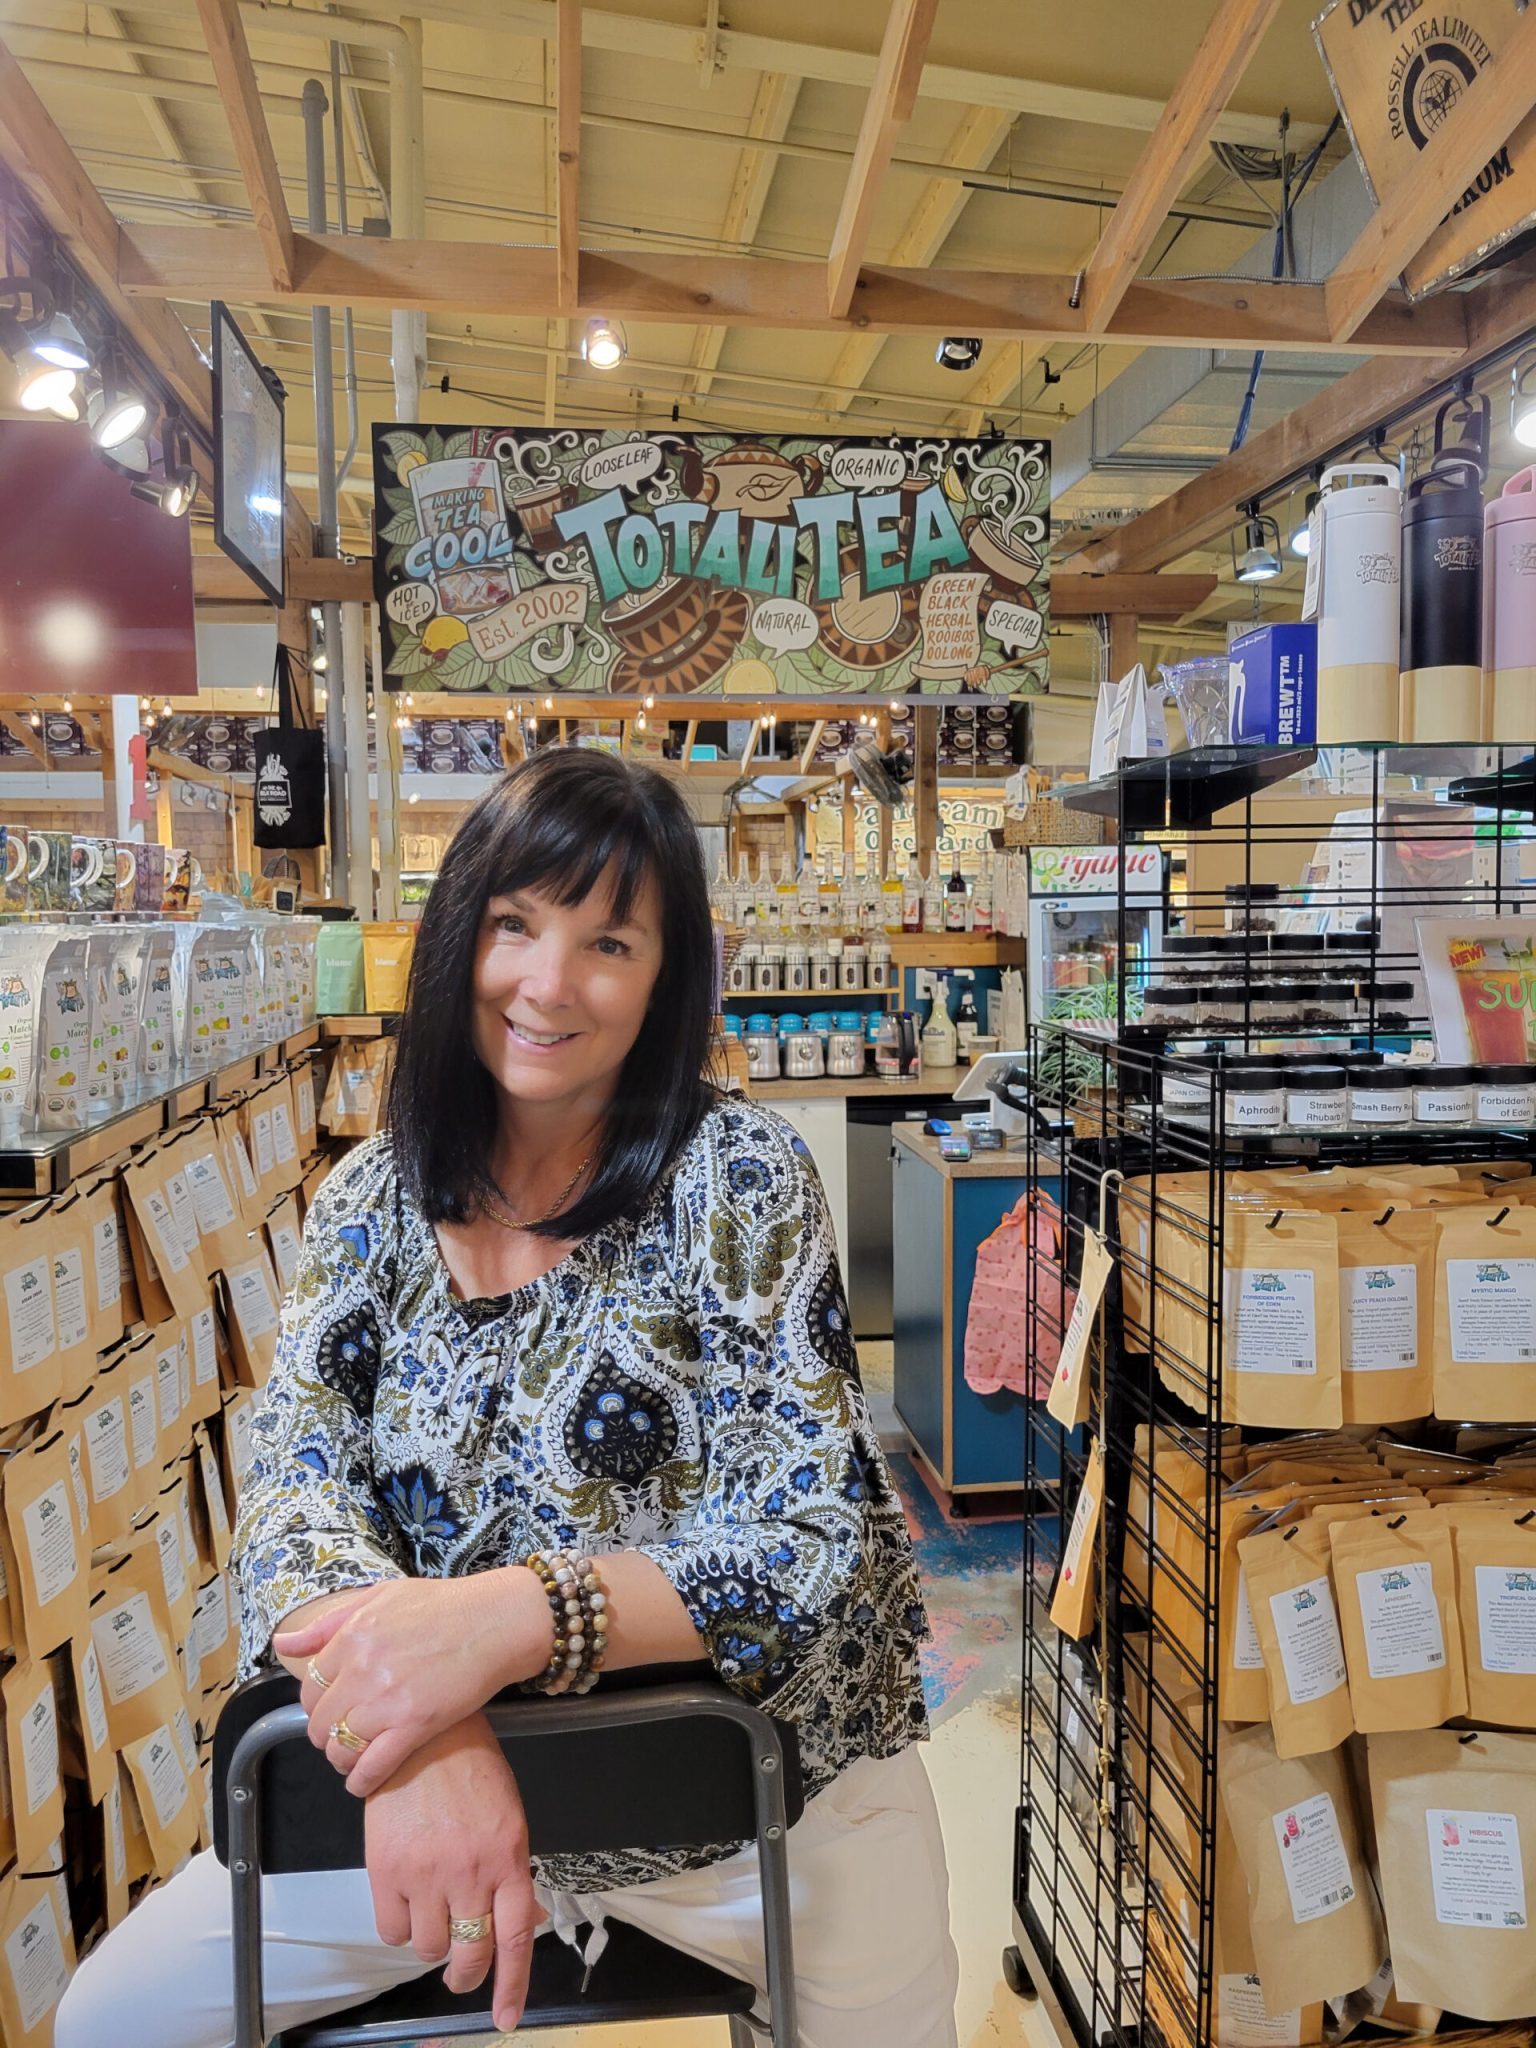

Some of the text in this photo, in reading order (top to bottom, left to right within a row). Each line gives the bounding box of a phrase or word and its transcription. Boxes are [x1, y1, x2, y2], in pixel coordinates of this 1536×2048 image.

[1387, 15, 1493, 141] ROSSELL TEA LIMITE
[834, 454, 900, 478] ORGANIC
[431, 487, 485, 510] MAKING
[435, 506, 482, 531] TEA
[404, 520, 514, 579] COOL
[931, 577, 976, 594] GREEN
[392, 584, 421, 608] HOT
[927, 595, 970, 611] BLACK
[400, 601, 431, 622] ICED
[925, 612, 973, 628] HERBAL
[475, 590, 580, 652] Est. 2002
[754, 612, 811, 630] NATURAL
[988, 608, 1038, 640] SPECIAL
[926, 630, 976, 645] ROOIBOS
[926, 646, 974, 661] OOLONG
[1448, 943, 1487, 968] NEW!
[1309, 1101, 1344, 1110] Strawber
[1351, 1102, 1379, 1112] Smash
[1380, 1103, 1402, 1114] Berry
[1481, 1096, 1526, 1106] Forbidden
[1500, 1108, 1531, 1117] of Eden
[1469, 1828, 1504, 1838] HIBISCUS
